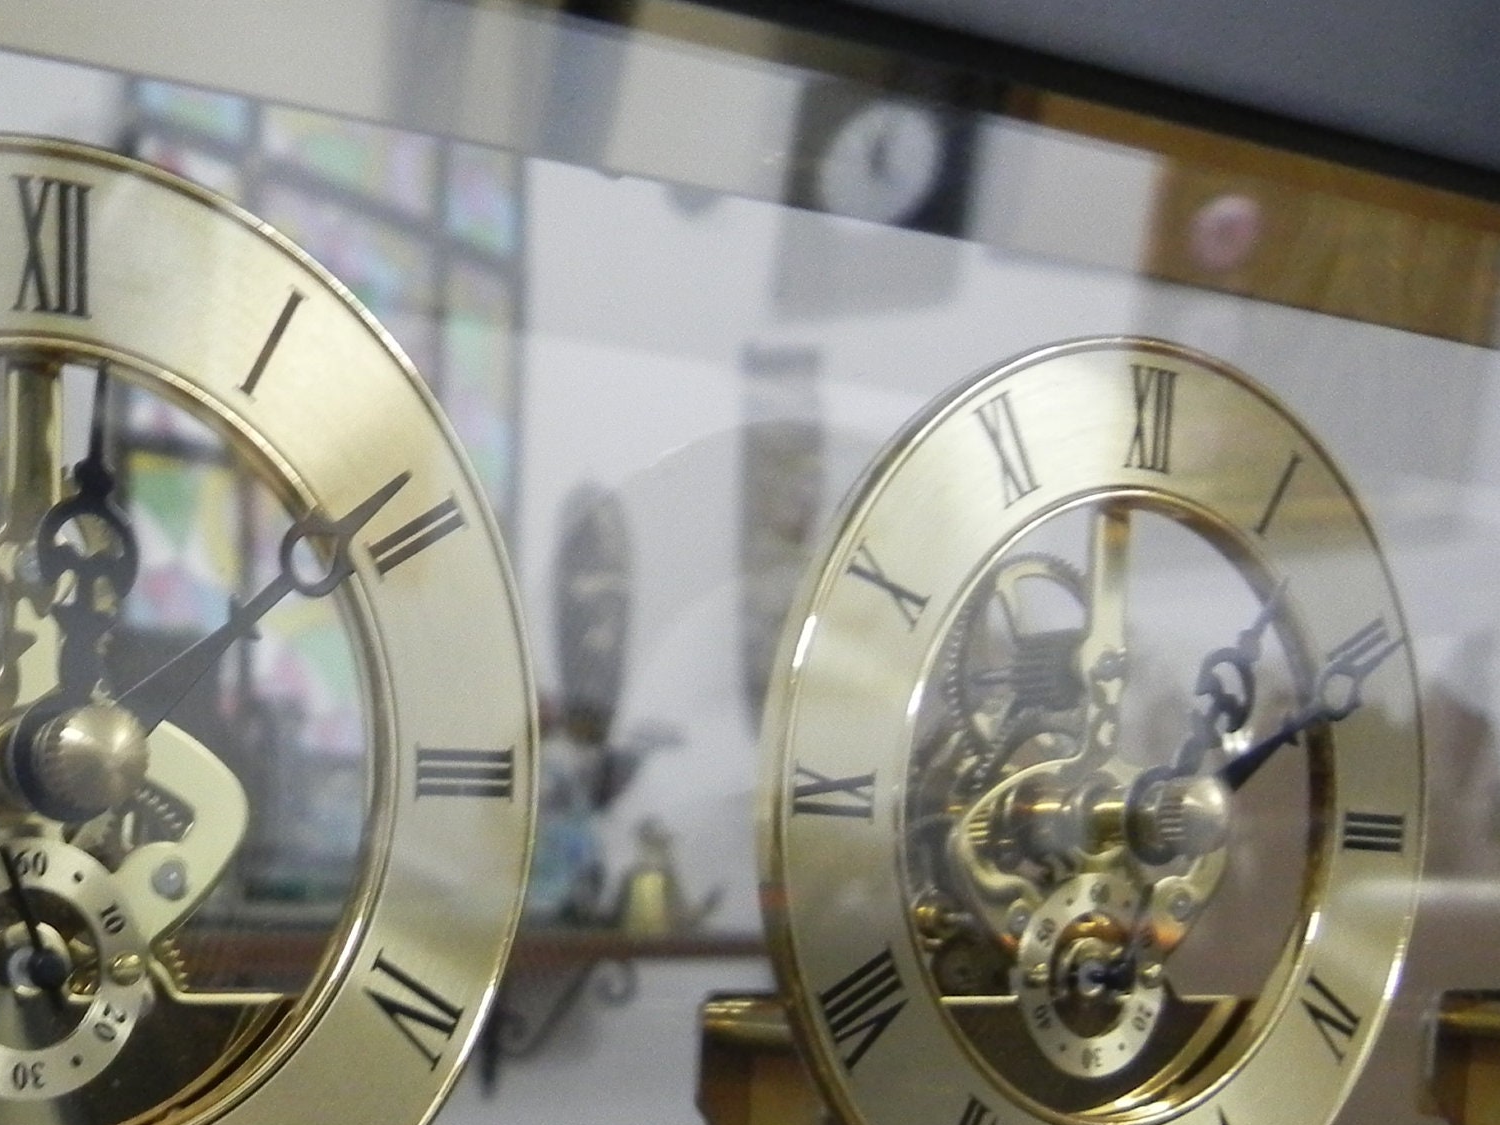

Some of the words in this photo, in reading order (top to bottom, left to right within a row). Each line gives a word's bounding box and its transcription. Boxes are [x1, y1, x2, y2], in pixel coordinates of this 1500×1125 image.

[12, 175, 94, 321] XII
[237, 286, 308, 398] I
[976, 390, 1041, 509] XI
[1125, 364, 1177, 474] XII
[363, 490, 469, 582] II
[846, 537, 931, 631] X
[416, 743, 515, 801] III
[792, 766, 876, 823] IX
[1343, 812, 1405, 851] III
[101, 903, 126, 935] 10
[365, 948, 464, 1072] IV
[817, 941, 909, 1071] VIII
[11, 1060, 47, 1091] 30
